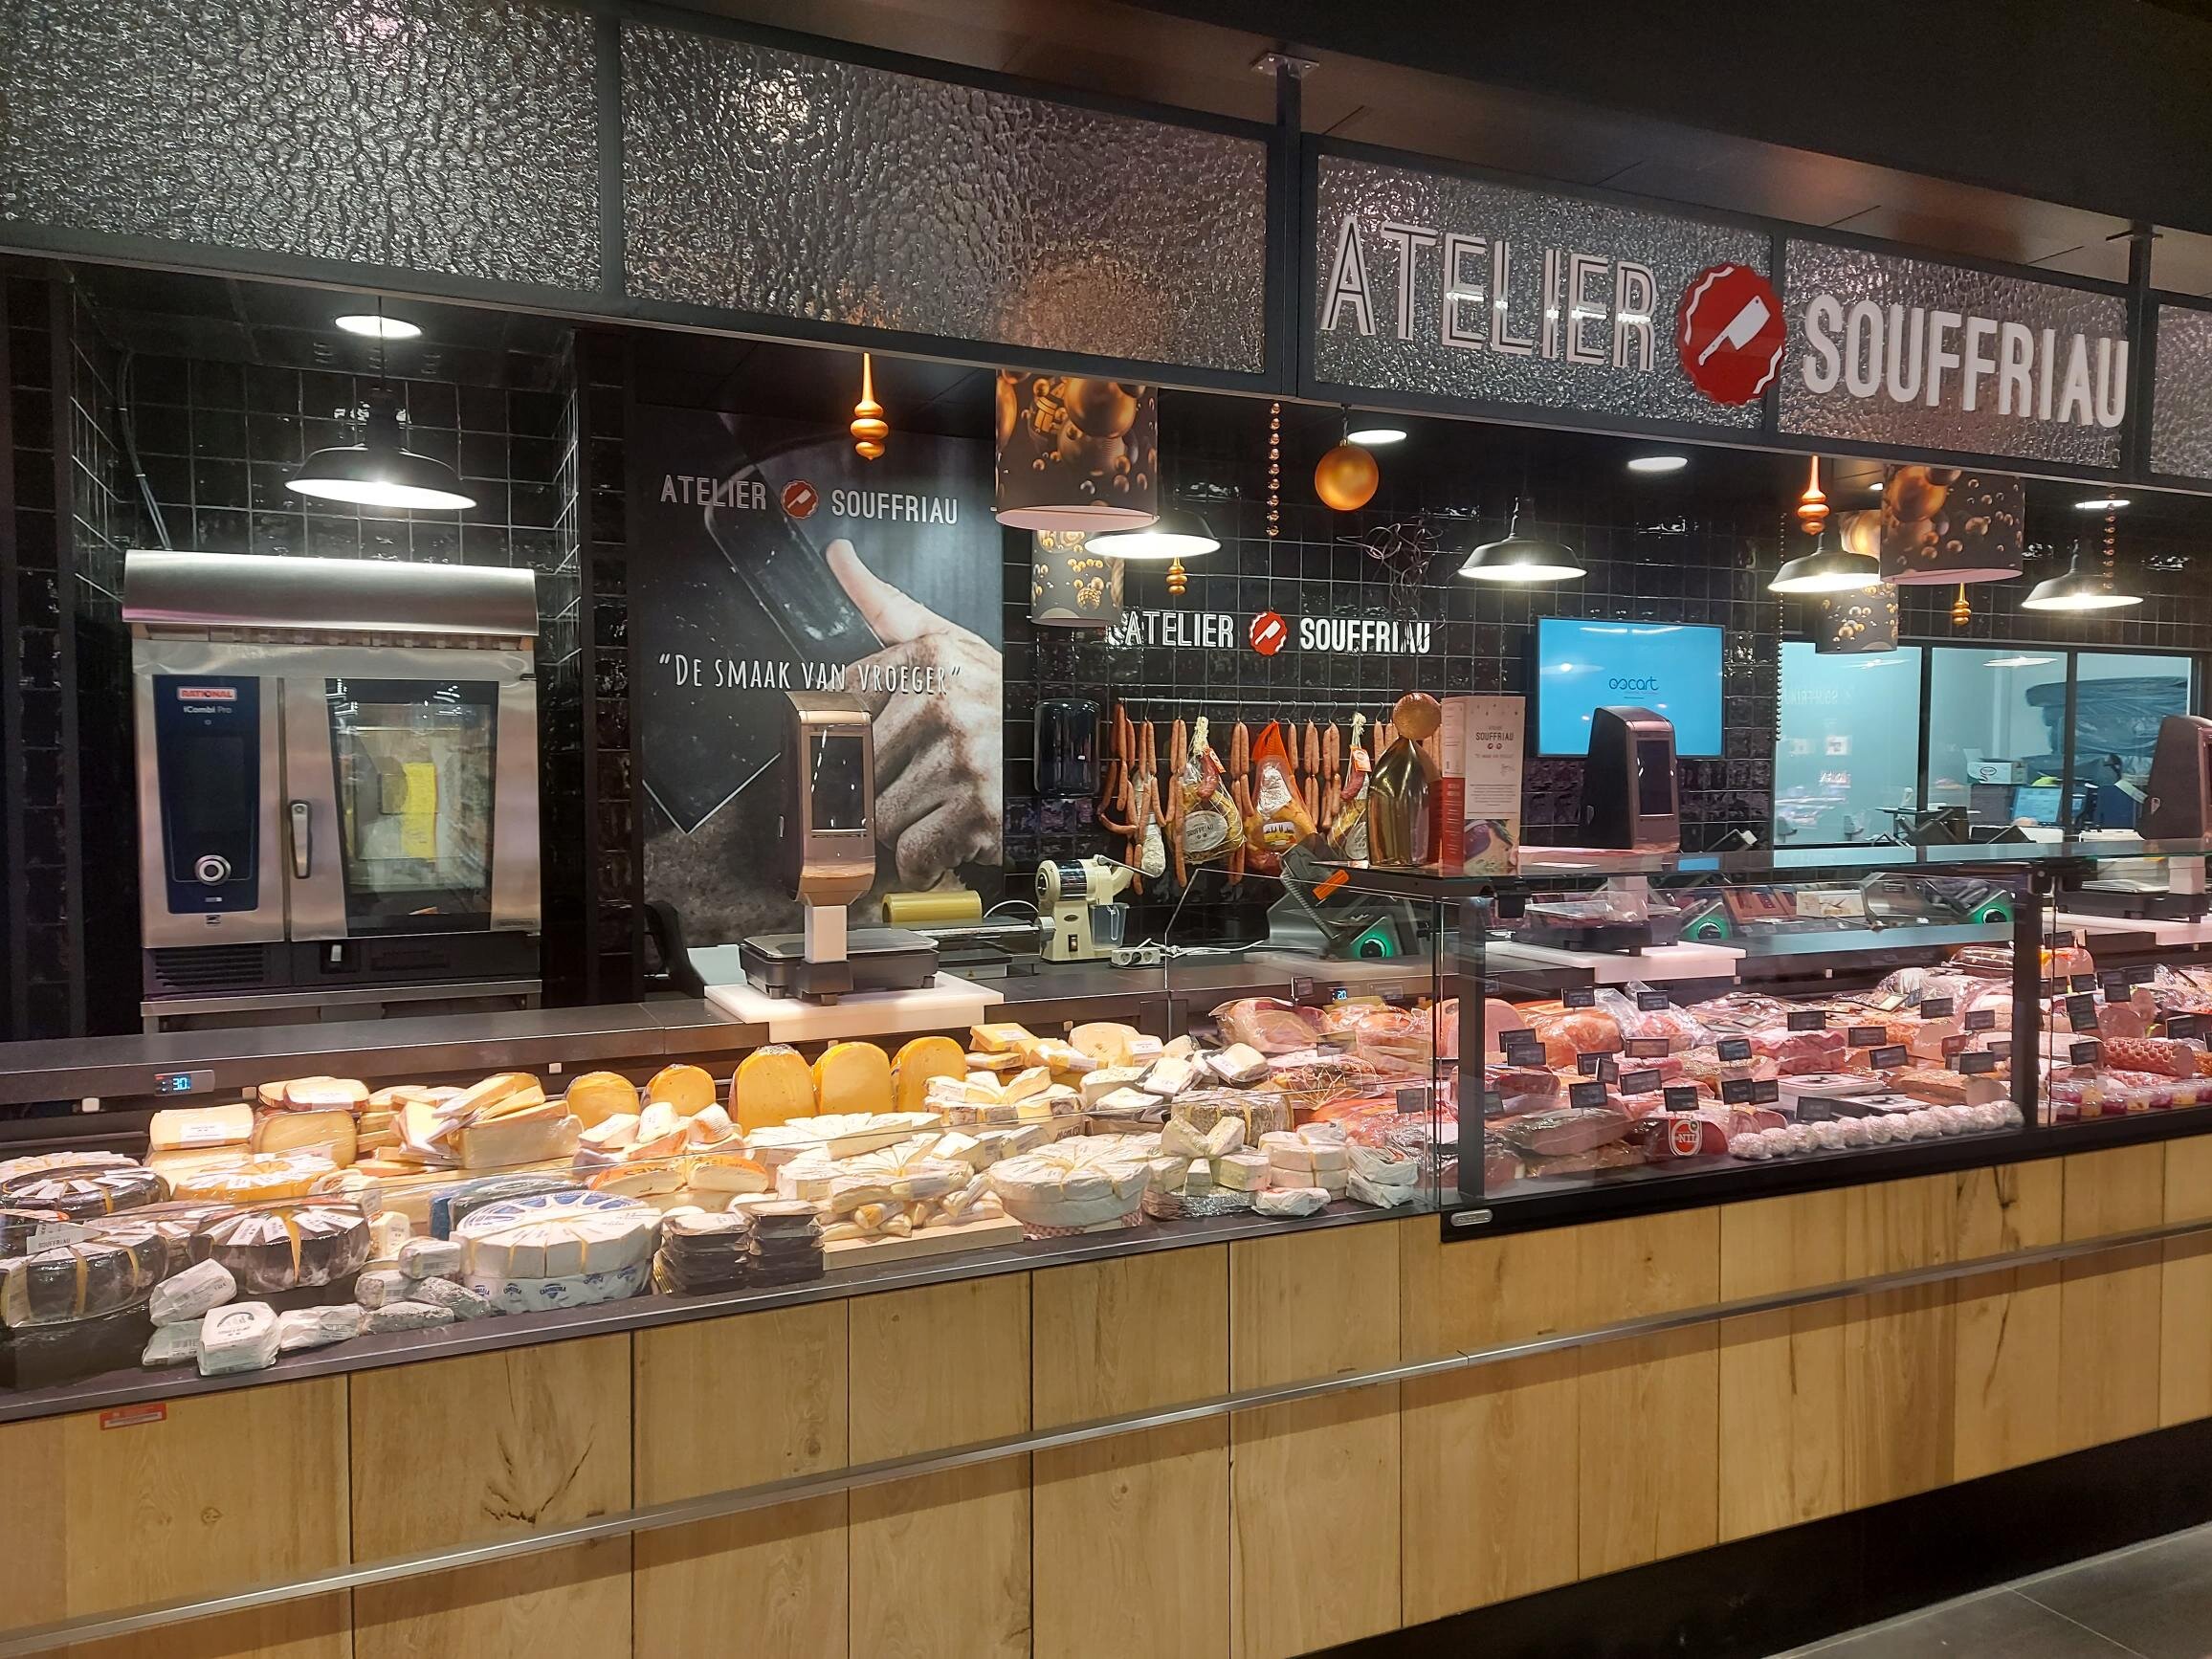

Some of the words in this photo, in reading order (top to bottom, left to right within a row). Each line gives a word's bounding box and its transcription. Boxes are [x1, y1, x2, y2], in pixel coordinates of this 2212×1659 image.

[1319, 215, 1659, 371] ATELIER
[1803, 295, 2130, 428] SOUFFRIAU
[660, 475, 766, 510] ATELIER
[831, 489, 958, 524] SOUFFRIAU
[1125, 611, 1234, 648] ATELIER
[1299, 617, 1430, 654] SOUFFRIAU
[715, 658, 792, 690] SMAAK
[801, 661, 846, 692] VAN
[1608, 676, 1660, 691] oscart
[182, 690, 233, 698] RATIONAL
[1475, 732, 1515, 741] SOUFFRIAU
[1185, 824, 1214, 837] SOUFFRIAU
[37, 1238, 71, 1249] SOUFFRIAU
